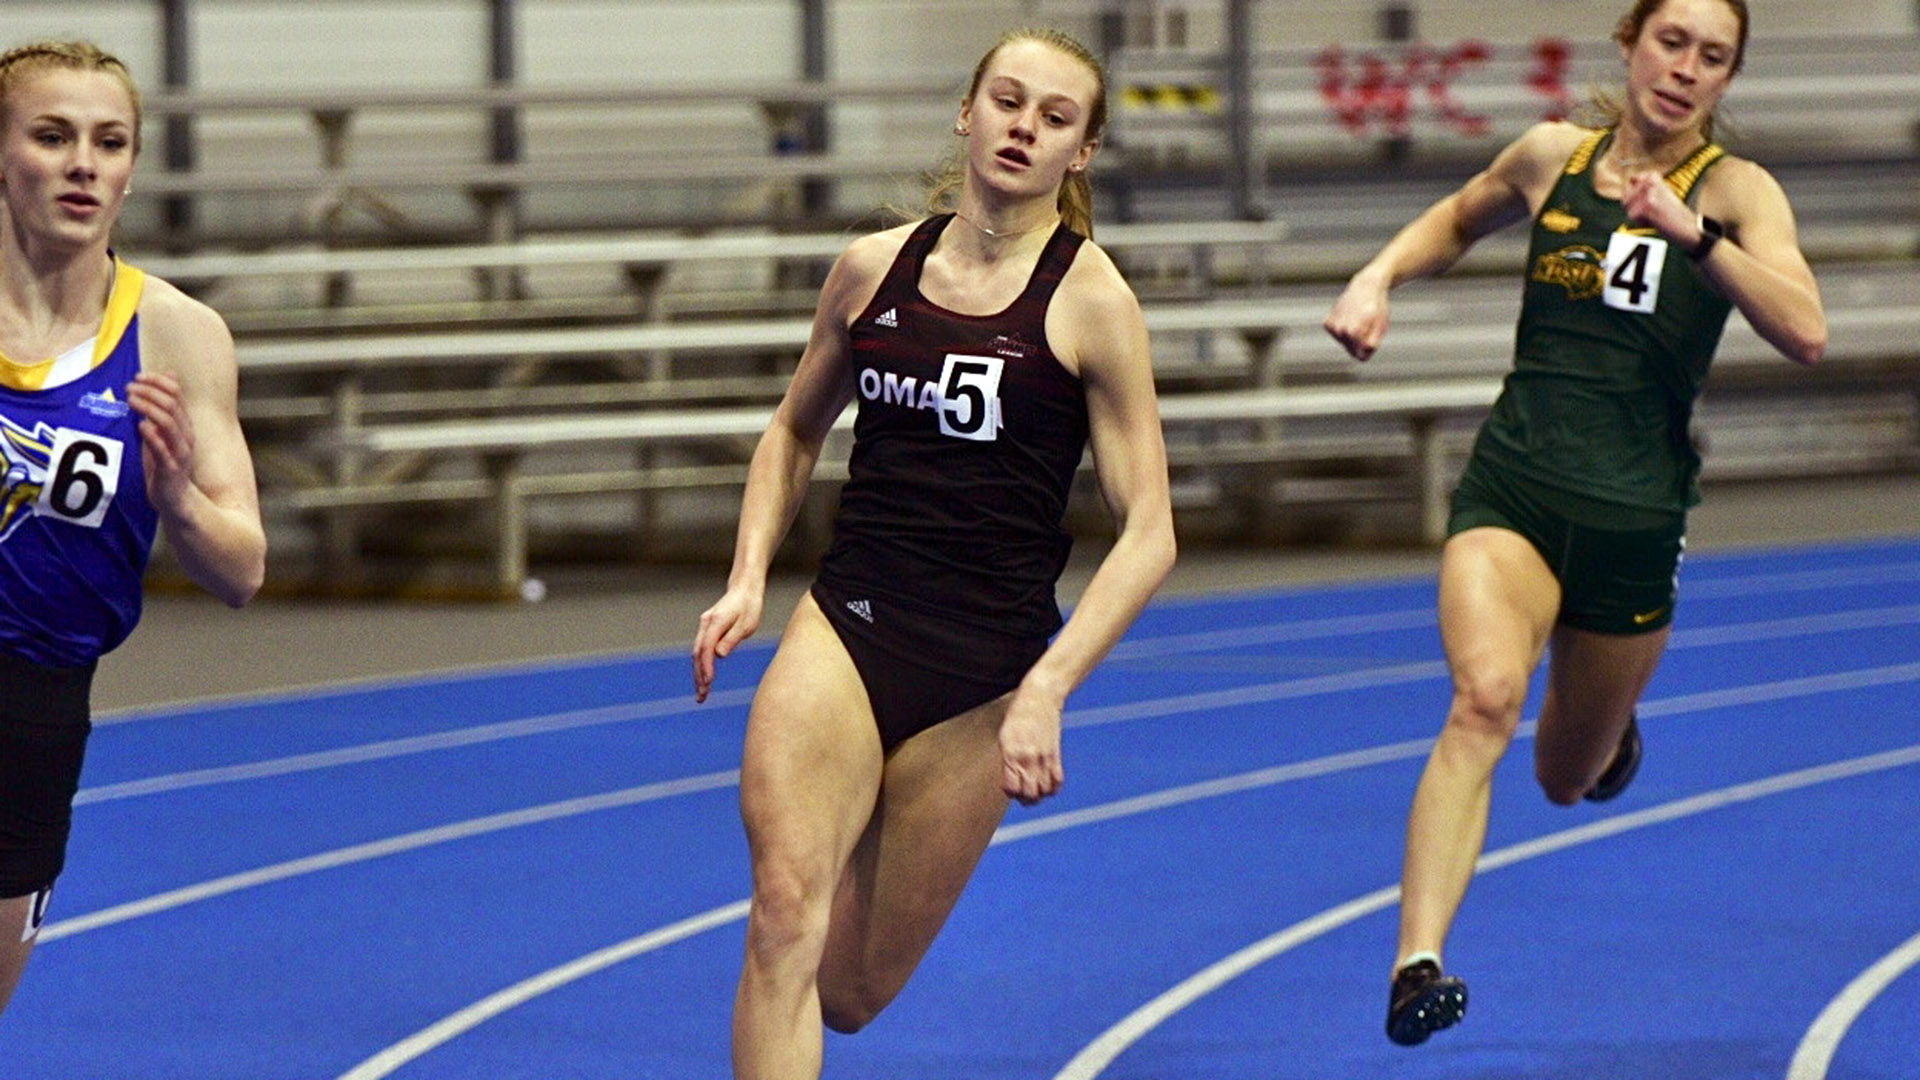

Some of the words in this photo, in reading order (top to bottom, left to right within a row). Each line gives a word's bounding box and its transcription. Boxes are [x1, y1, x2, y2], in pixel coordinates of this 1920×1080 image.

[1610, 243, 1650, 305] 4
[944, 361, 989, 434] 5
[50, 440, 109, 519] 6
